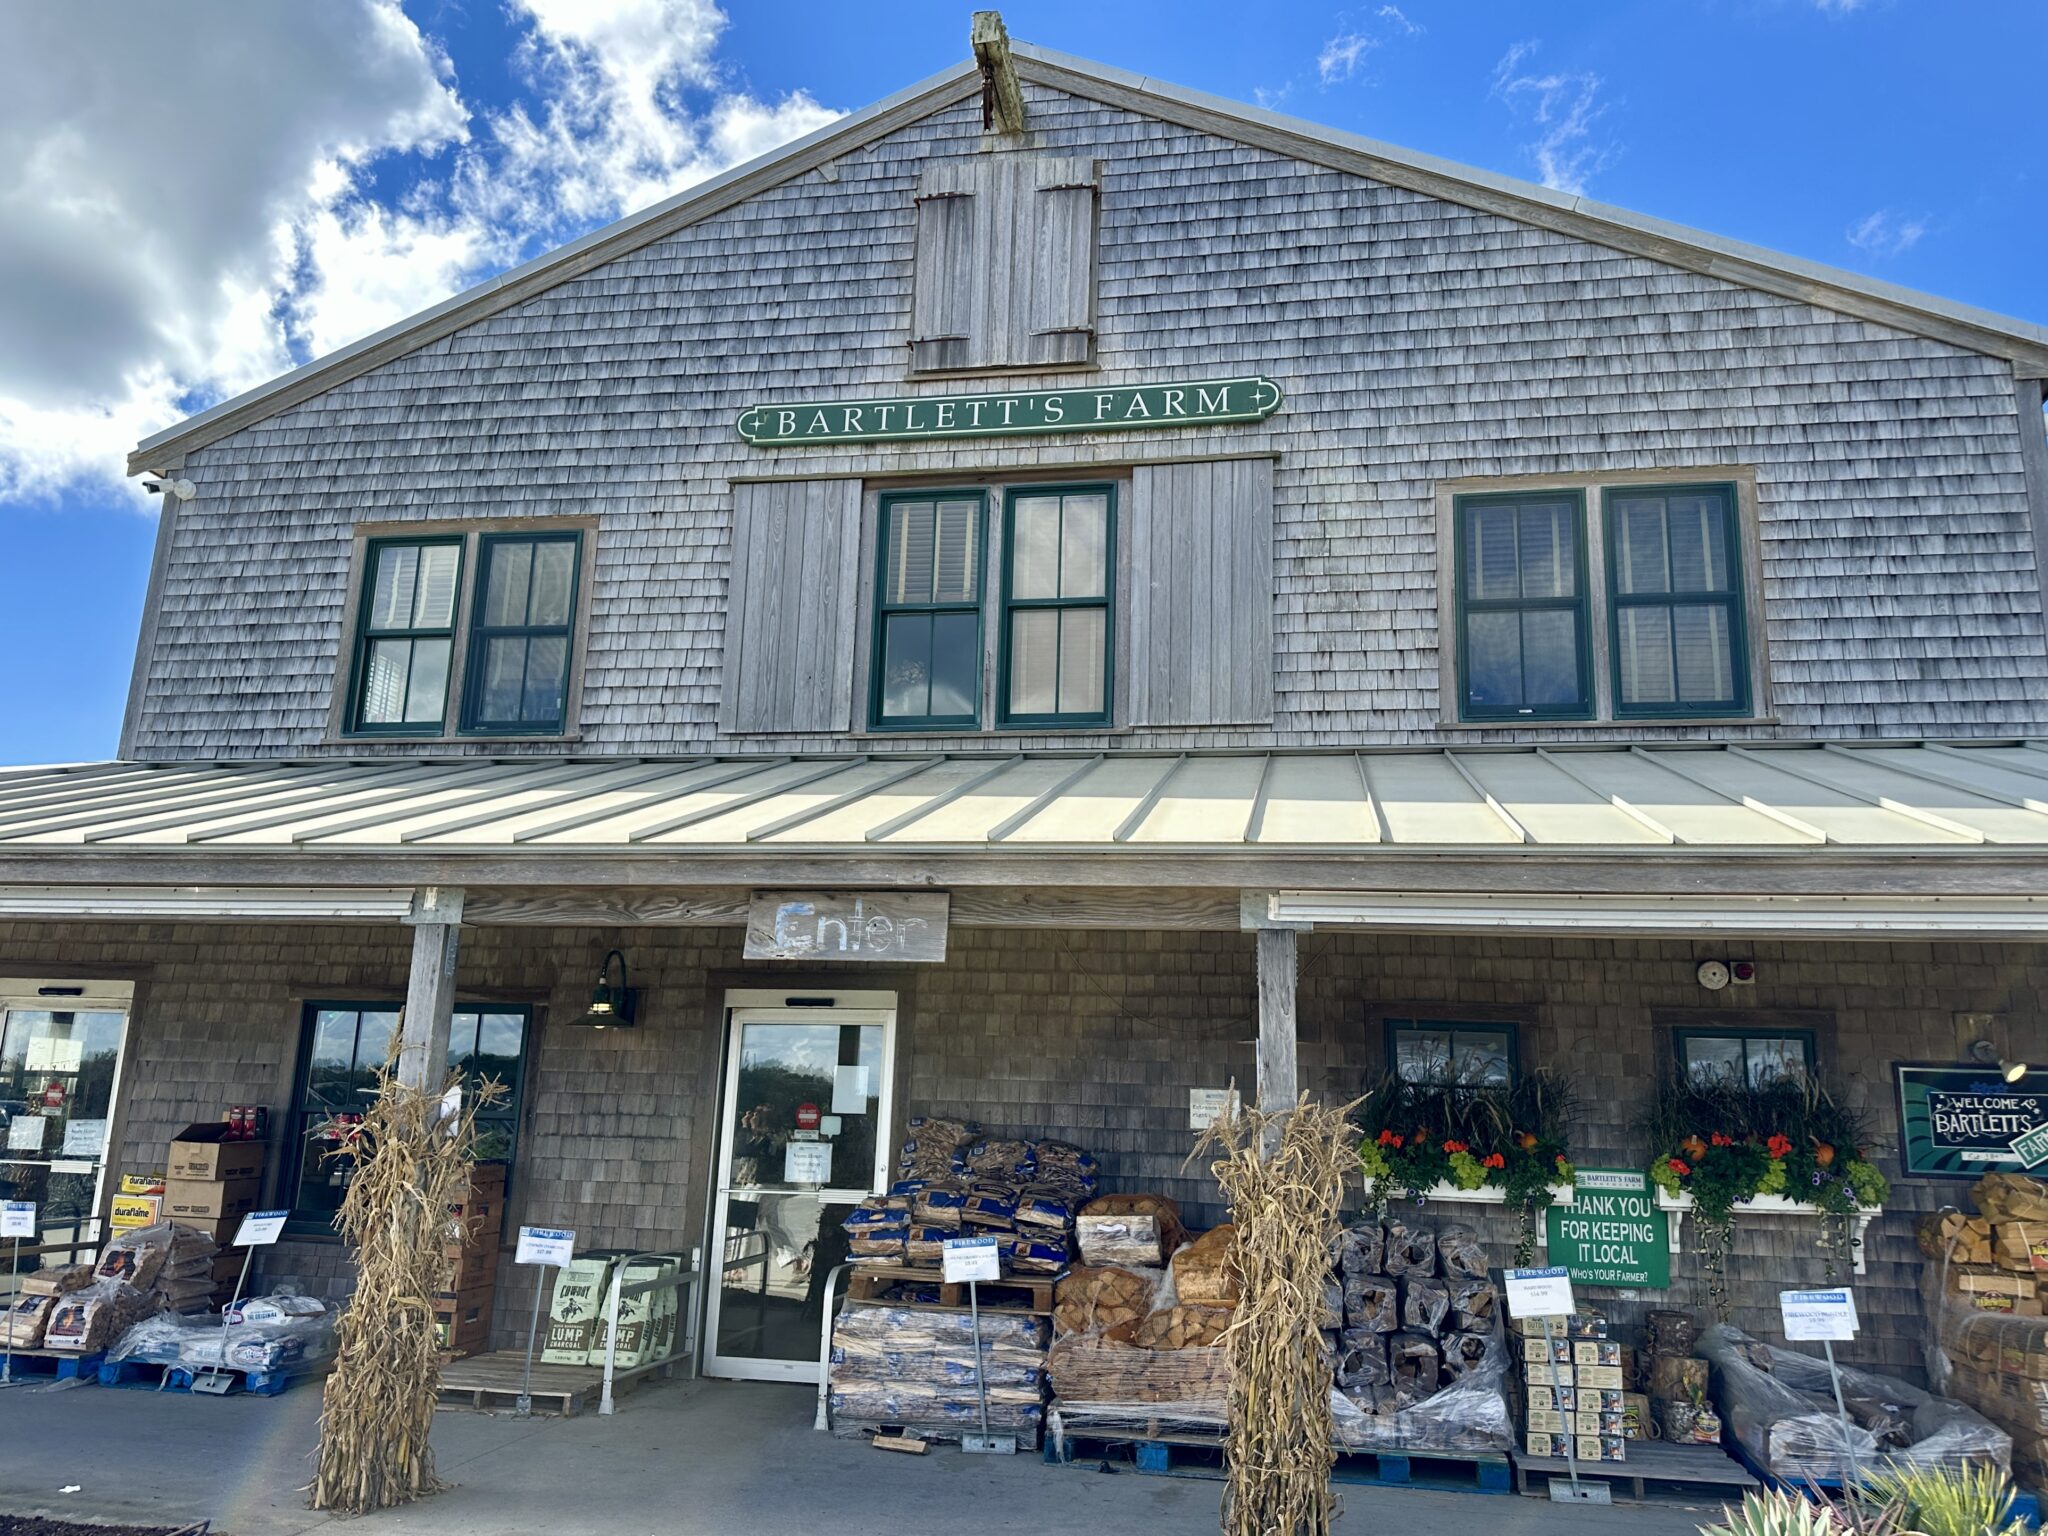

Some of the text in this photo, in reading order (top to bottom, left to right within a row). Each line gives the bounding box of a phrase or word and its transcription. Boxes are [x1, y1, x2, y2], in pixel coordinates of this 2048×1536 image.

[777, 385, 1231, 436] BARTLETT'S FARM
[774, 897, 928, 952] Enter
[1950, 1097, 2020, 1110] WELCOME
[129, 1176, 161, 1186] duraflame
[1587, 1174, 1642, 1184] BARTLETT'S FARM
[114, 1206, 150, 1218] duraflame
[1617, 1197, 1651, 1218] YOU
[1561, 1220, 1654, 1243] FOR KEEPING
[954, 1237, 994, 1247] FIREWOOD
[1579, 1243, 1638, 1265] IT LOCAL
[1517, 1267, 1565, 1277] FIREWOOD
[1594, 1269, 1617, 1281] YOUR
[560, 1284, 592, 1299] COWBOY
[551, 1327, 584, 1342] LUMP
[601, 1328, 635, 1343] LMP
[549, 1340, 580, 1349] CHARCOAL
